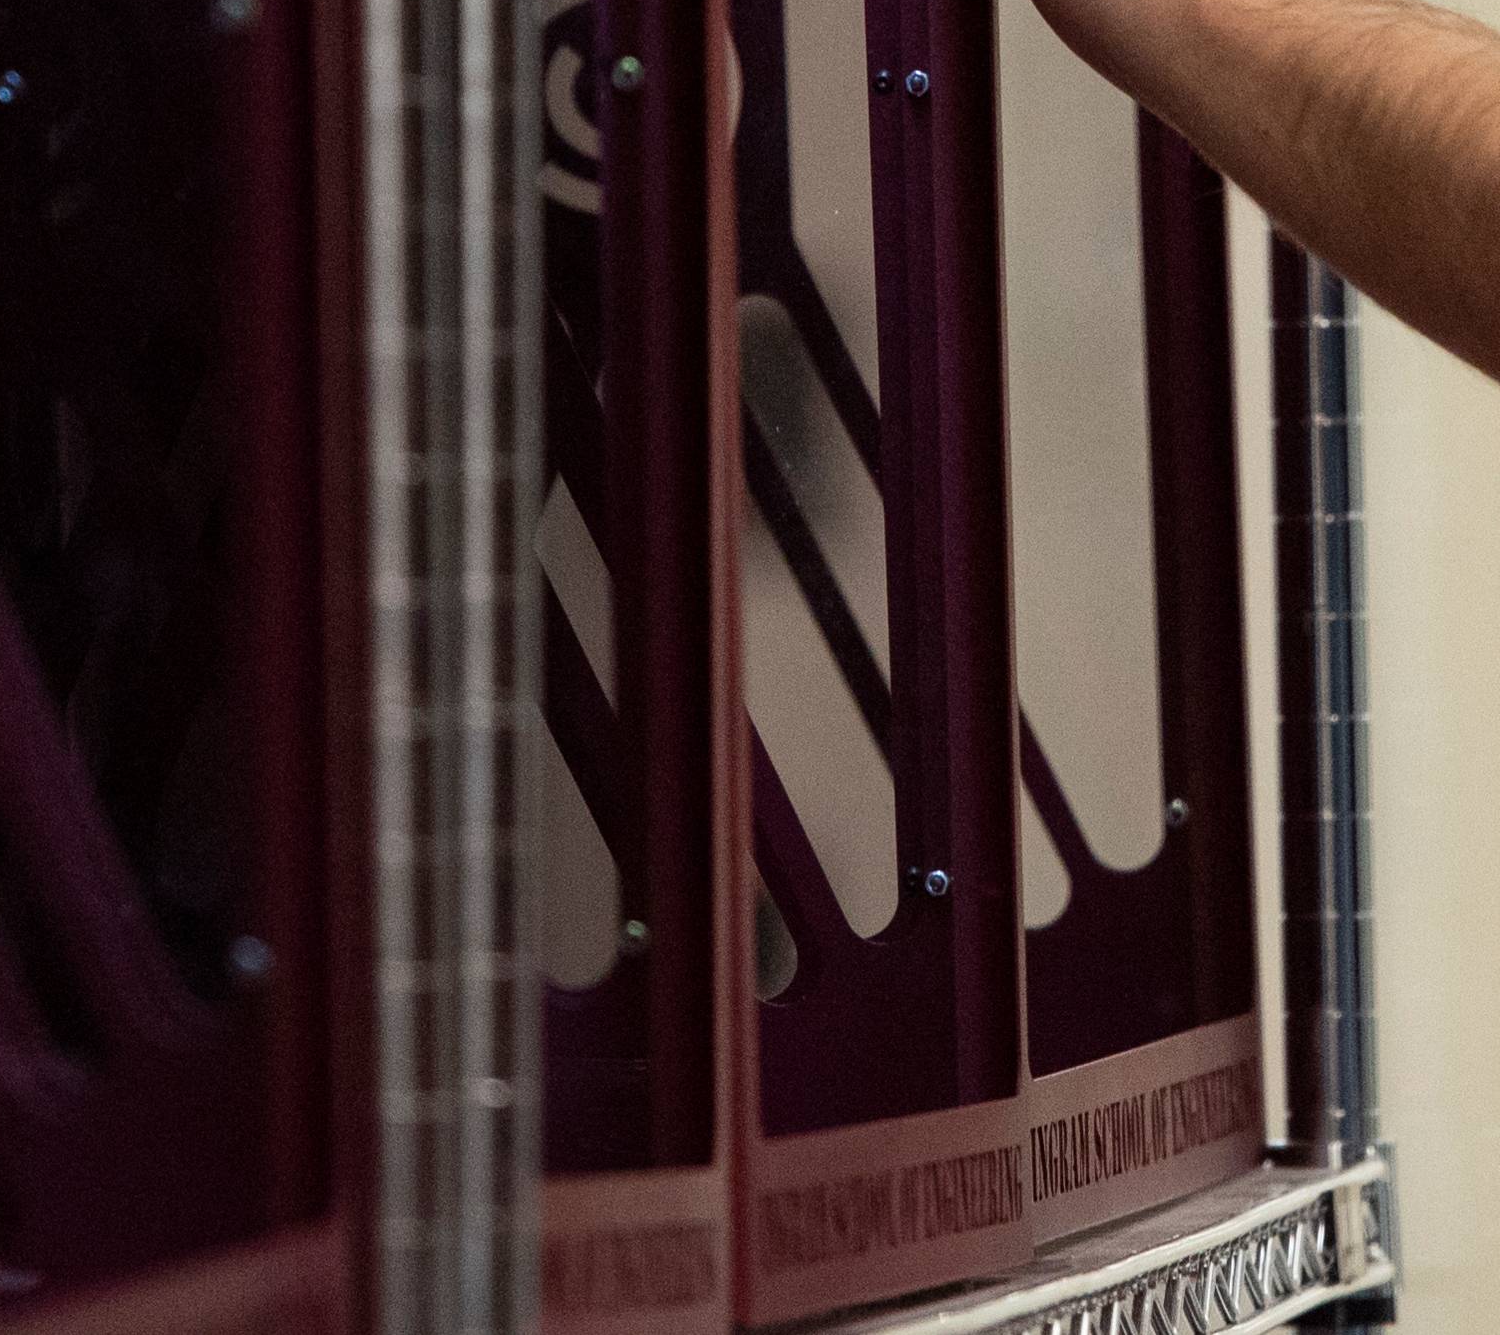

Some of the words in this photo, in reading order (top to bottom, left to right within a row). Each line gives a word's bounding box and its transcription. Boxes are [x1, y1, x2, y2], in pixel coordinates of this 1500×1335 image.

[1030, 1111, 1091, 1202] INGRAM
[1093, 1093, 1150, 1181] SCHOOL
[1151, 1086, 1167, 1163] OF
[1169, 1056, 1257, 1156] ENGINEE
[922, 1145, 1022, 1240] ENGINEERING
